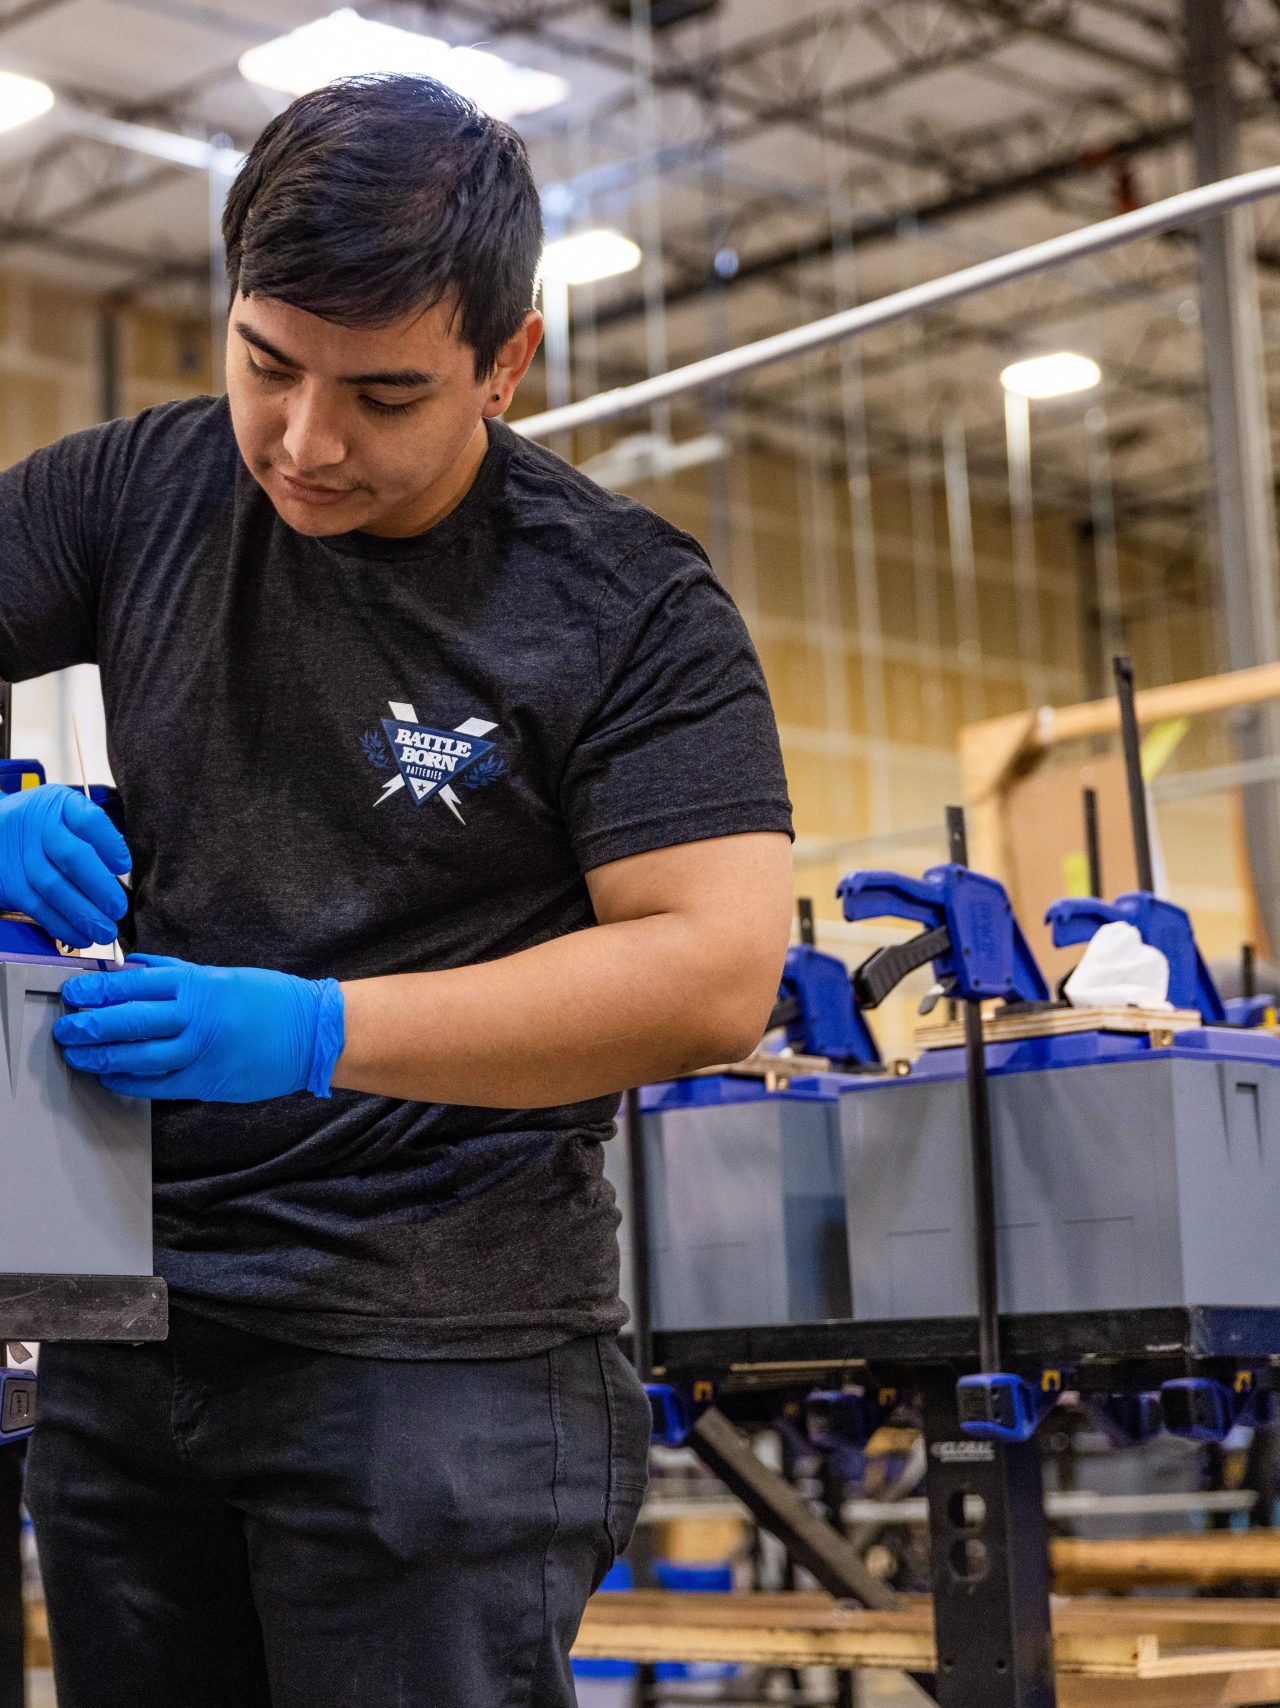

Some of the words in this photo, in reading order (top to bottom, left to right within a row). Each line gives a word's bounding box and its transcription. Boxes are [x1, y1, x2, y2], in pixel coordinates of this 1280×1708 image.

[394, 728, 472, 758] BATTLE
[400, 746, 459, 772] BORN
[406, 765, 443, 780] BATTERIES
